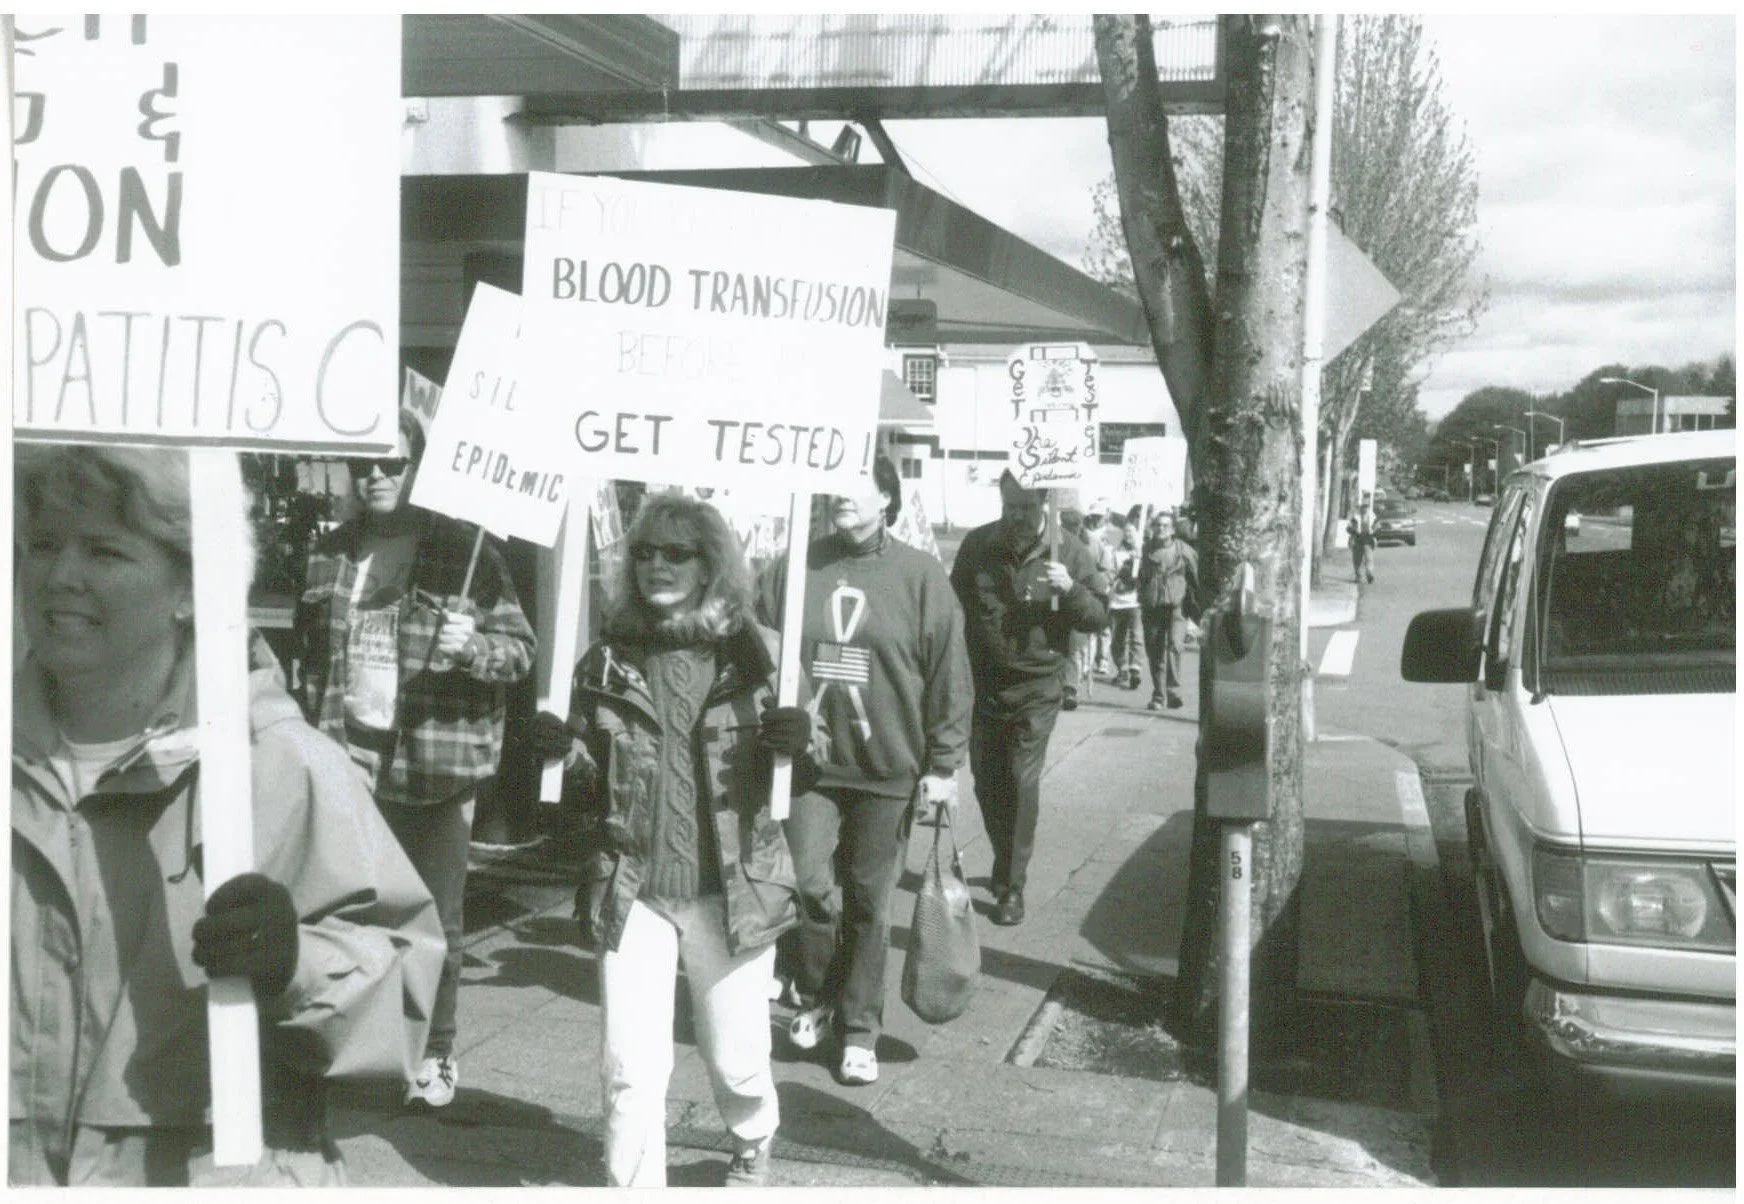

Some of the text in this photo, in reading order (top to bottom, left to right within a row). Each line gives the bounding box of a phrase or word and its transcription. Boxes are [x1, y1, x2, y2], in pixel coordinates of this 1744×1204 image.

[14, 158, 183, 267] ON
[552, 257, 886, 328] BLOOD TRANSFUSION
[24, 306, 386, 438] PATITIS C
[574, 410, 674, 456] GET
[1230, 850, 1243, 880] 58
